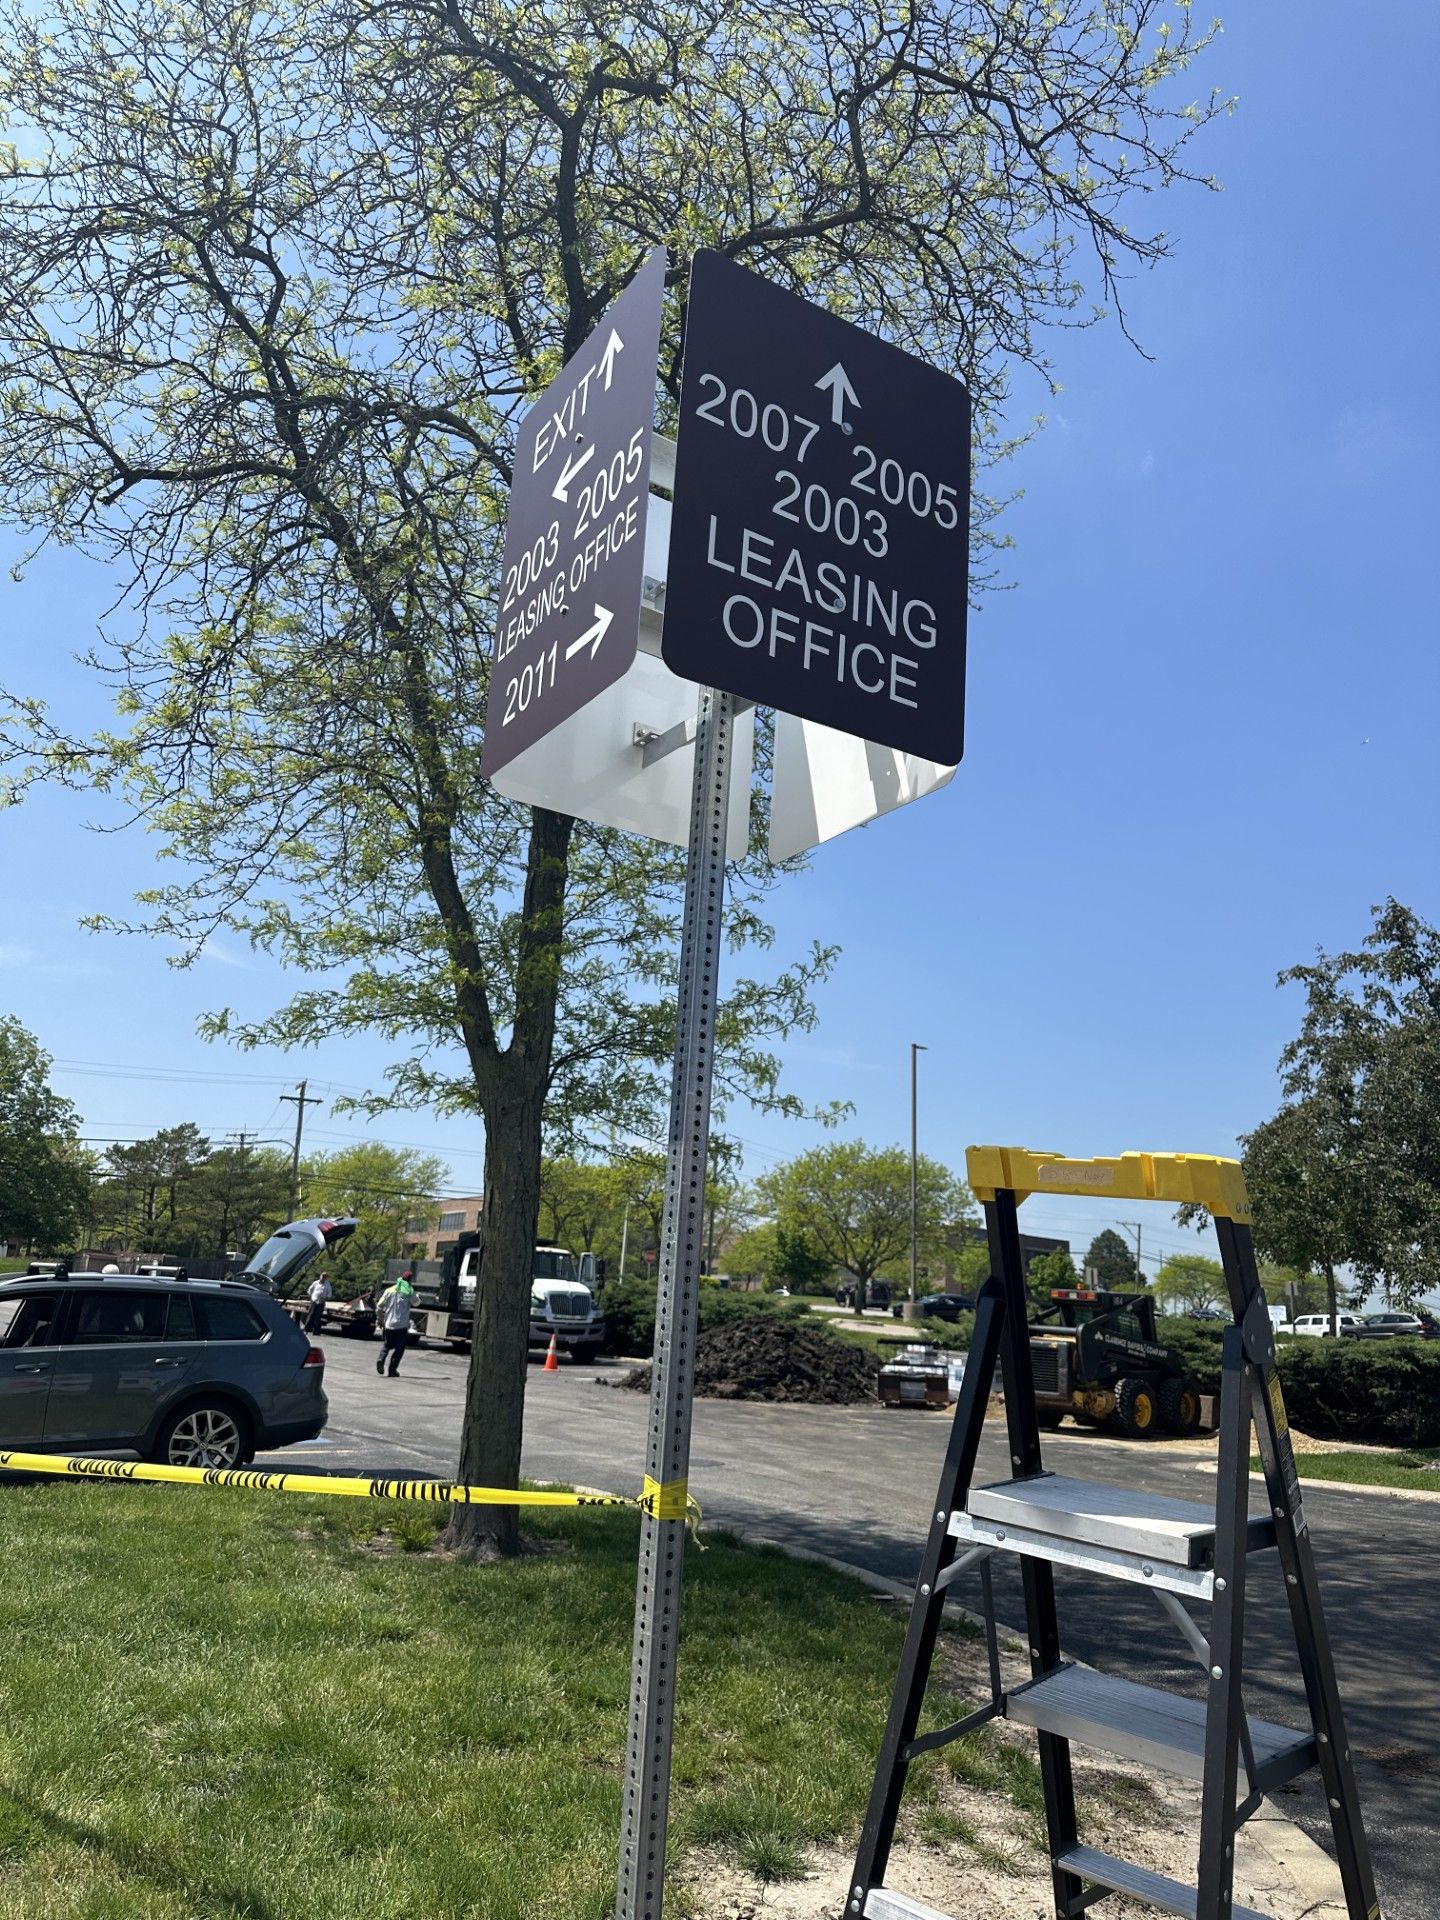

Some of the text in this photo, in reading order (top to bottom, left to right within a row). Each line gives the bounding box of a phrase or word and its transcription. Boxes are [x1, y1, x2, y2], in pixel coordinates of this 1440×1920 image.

[532, 364, 597, 474] EXIT
[695, 373, 958, 530] 2007 2005
[502, 426, 644, 613] 2003 2005
[772, 470, 889, 558] 2003
[497, 496, 639, 663] LEASING OFFICE
[707, 514, 937, 649] LEASING
[502, 640, 558, 727] 2011
[722, 594, 919, 709] OFFICE
